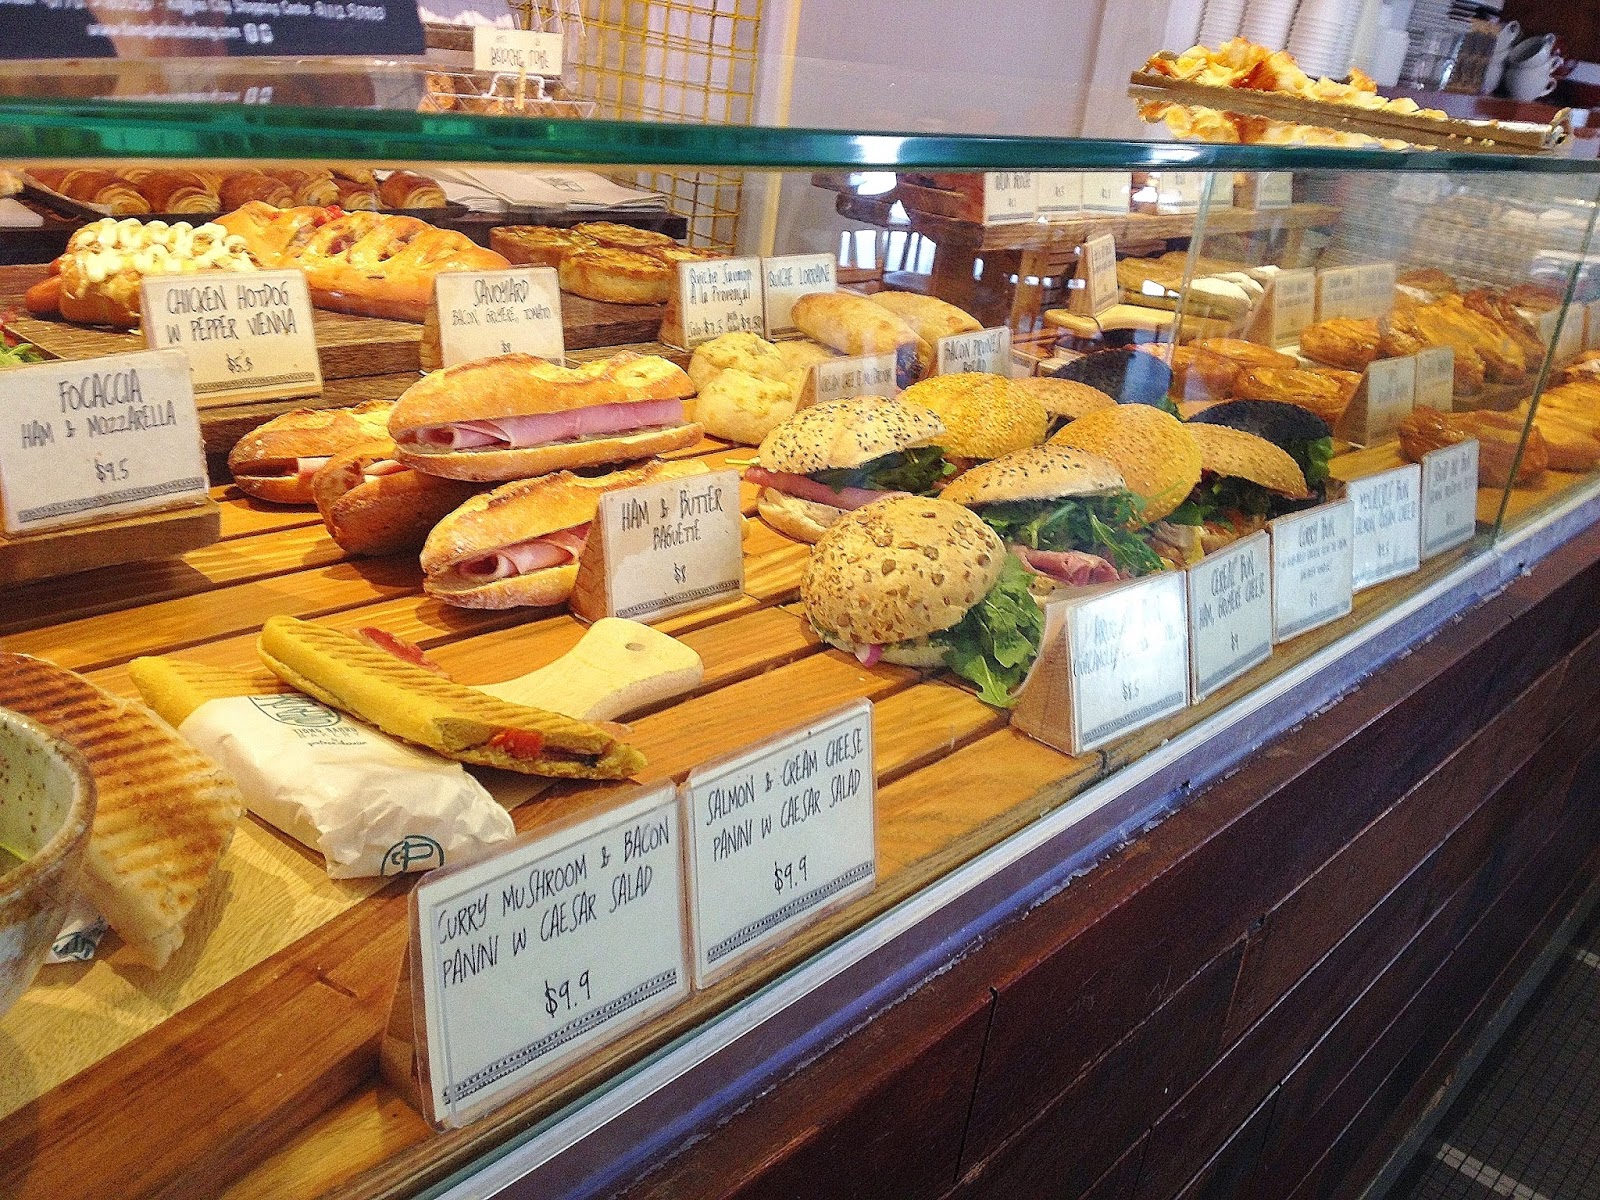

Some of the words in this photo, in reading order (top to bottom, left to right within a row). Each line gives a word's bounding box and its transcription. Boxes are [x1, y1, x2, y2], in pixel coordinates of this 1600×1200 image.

[167, 285, 228, 314] CHICKEN
[236, 281, 289, 309] HOTDOG
[190, 315, 239, 342] PEPPER
[247, 308, 298, 336] VIENNA
[944, 336, 971, 362] BACON
[58, 368, 143, 413] FOCACCIA
[21, 419, 55, 449] HAM
[87, 400, 177, 438] MOZZARELLA
[94, 457, 129, 484] $9.5
[621, 498, 649, 532] HAM
[679, 484, 723, 519] BUTTER
[653, 519, 701, 551] BAGUETTE
[706, 775, 755, 826] SALMON
[782, 749, 818, 787] CREAM
[825, 727, 864, 768] CHEESE
[713, 818, 753, 863] PANINI
[761, 815, 772, 840] W
[780, 787, 821, 829] CAESAR
[829, 768, 862, 809] SALAD
[437, 893, 489, 944] CURRY
[502, 854, 588, 917] MUSHROOM
[624, 815, 670, 863] BACON
[774, 855, 808, 895] $9.9
[442, 935, 499, 989] PANINI
[512, 928, 527, 957] W
[540, 891, 598, 943] CAESAR
[609, 865, 653, 914] SALAD
[544, 969, 591, 1018] $9.9
